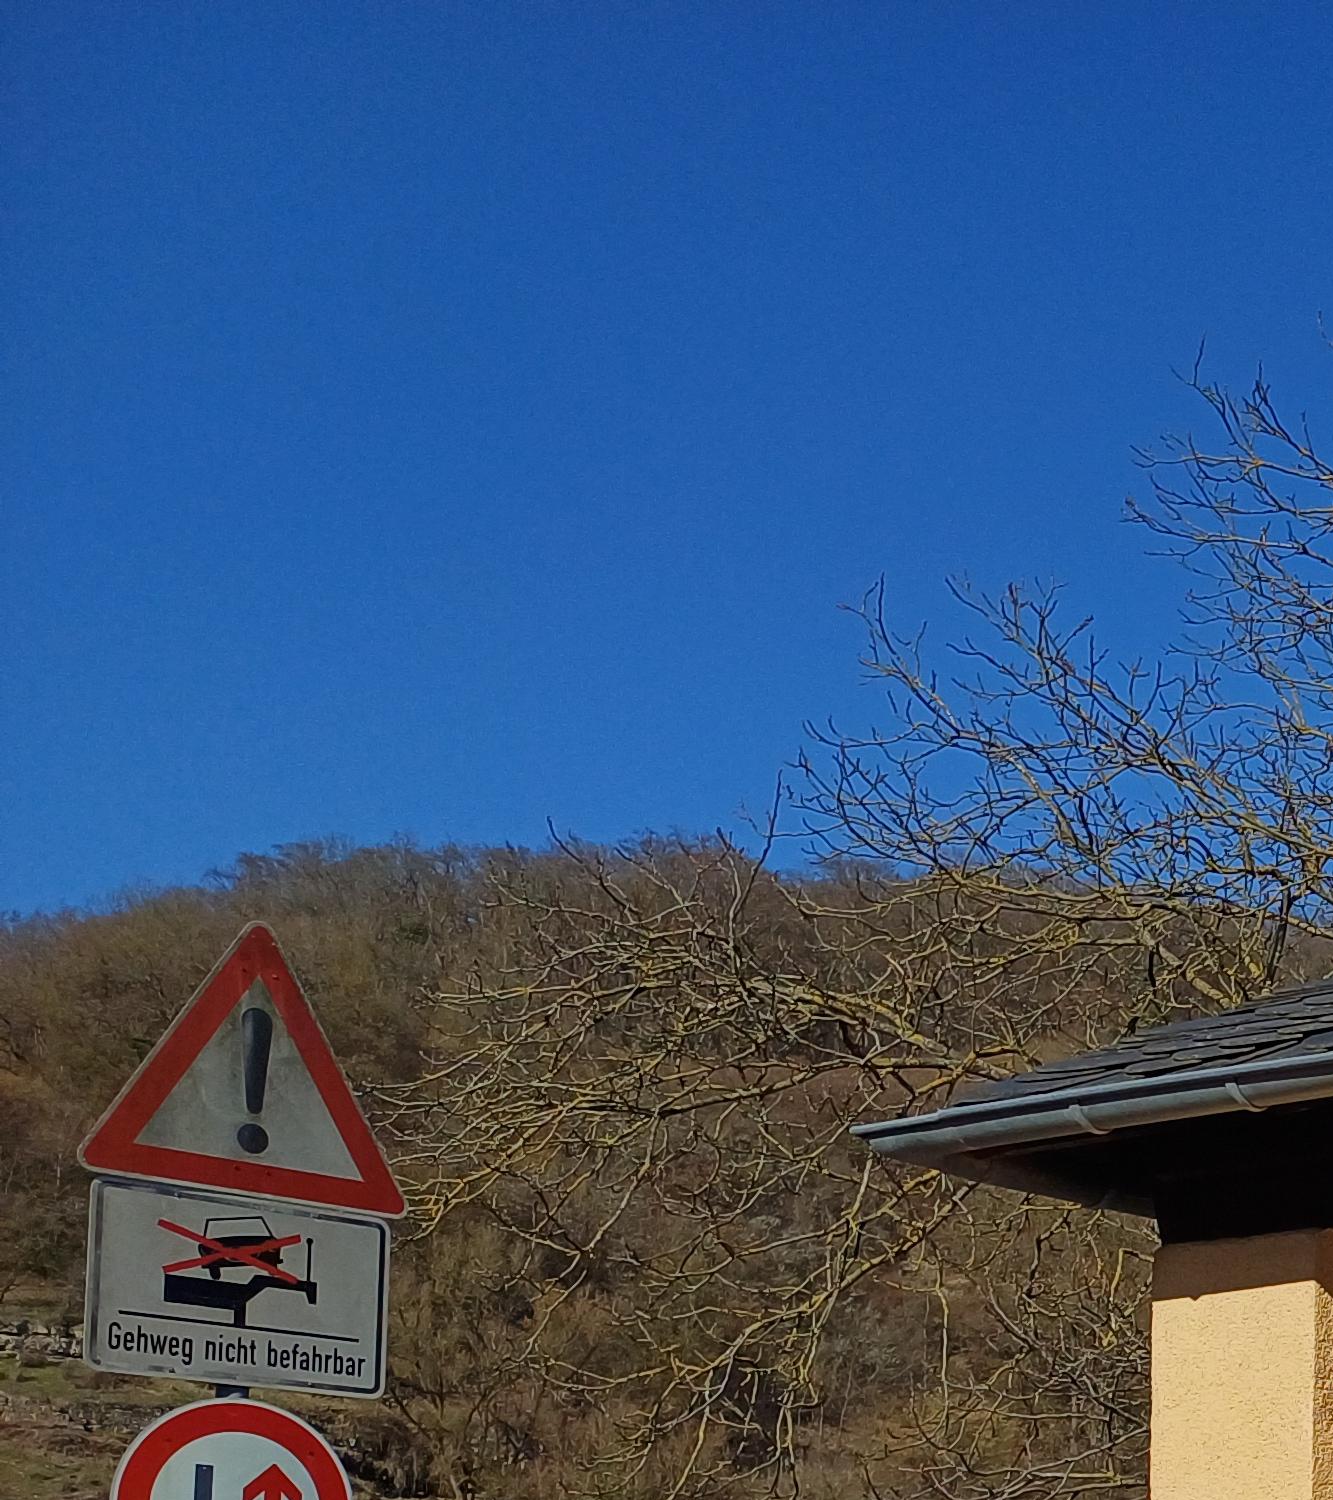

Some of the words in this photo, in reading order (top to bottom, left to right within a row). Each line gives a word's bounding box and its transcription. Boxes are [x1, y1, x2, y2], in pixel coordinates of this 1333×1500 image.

[107, 1321, 194, 1366] Gehweg
[204, 1334, 257, 1366] nicht
[266, 1339, 367, 1378] befahrbar
